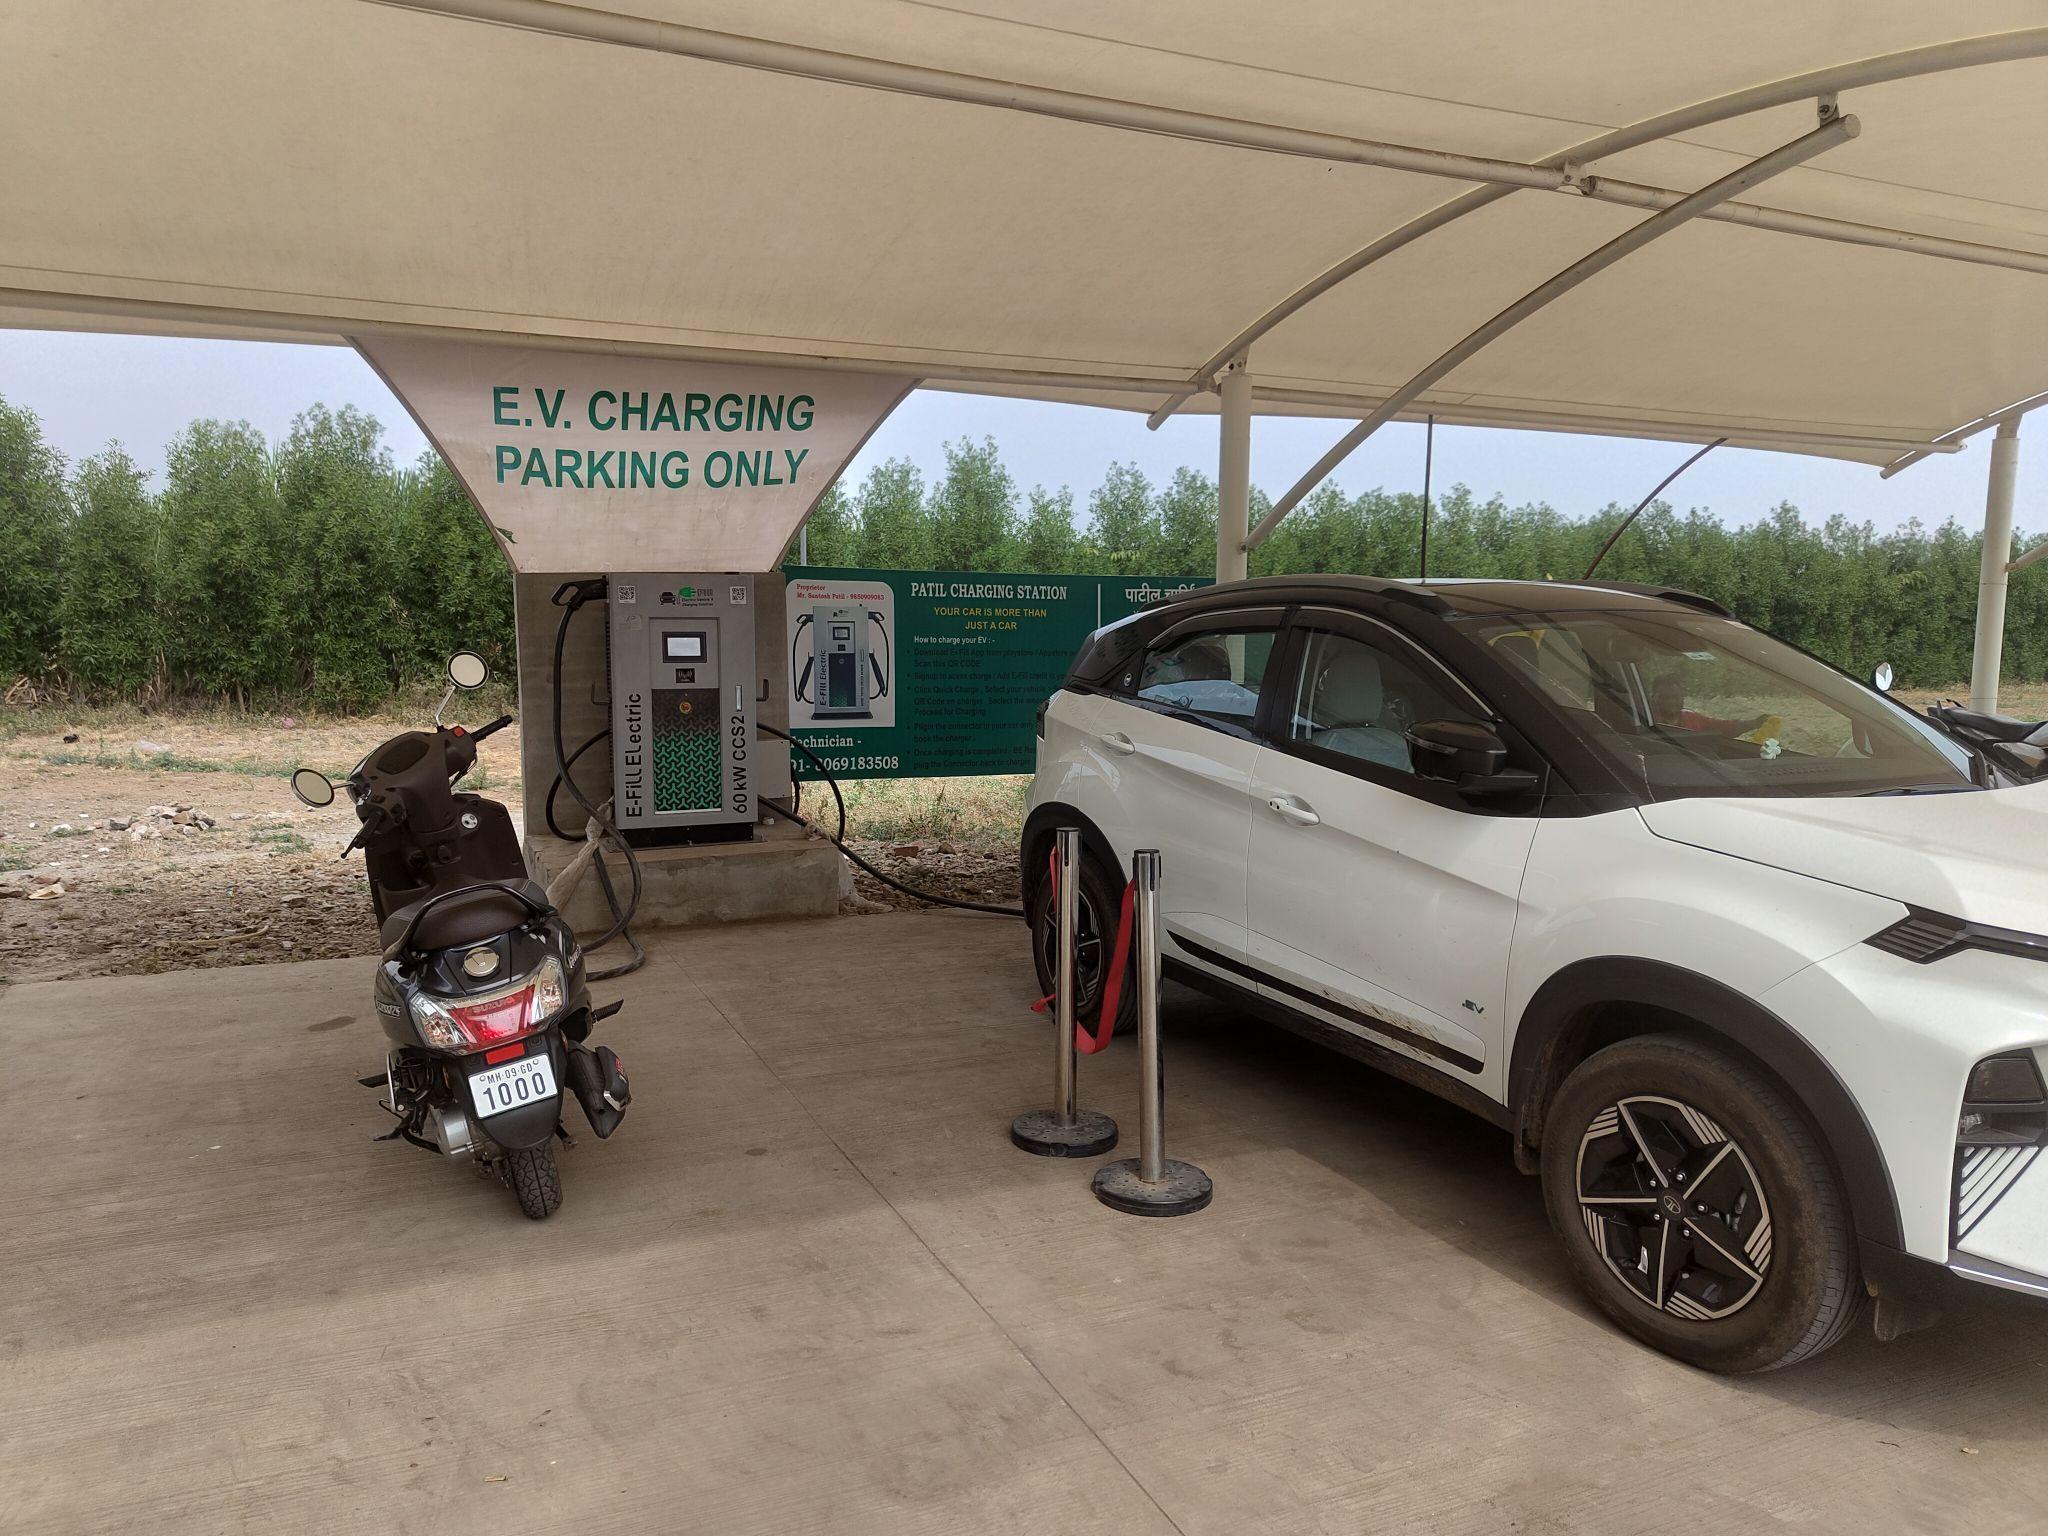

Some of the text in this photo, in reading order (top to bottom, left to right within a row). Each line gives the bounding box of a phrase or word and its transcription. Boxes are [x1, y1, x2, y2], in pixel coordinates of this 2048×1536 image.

[493, 386, 815, 432] E.V. CHARGING
[495, 445, 809, 489] PARKING ONLY
[808, 592, 831, 600] Santosh
[911, 582, 1068, 600] PATIL CHARGING STATION
[1125, 583, 1161, 603] पाटील
[933, 607, 960, 616] YOUR
[962, 607, 982, 616] CAR
[994, 608, 1021, 617] MORE
[1023, 608, 1047, 617] THAN
[965, 621, 1018, 630] JUST A CAR
[914, 635, 929, 644] How
[930, 636, 937, 644] to
[938, 636, 961, 645] charge
[961, 637, 976, 645] your
[977, 636, 987, 644] EV
[731, 715, 746, 761] CCS2
[790, 735, 854, 748] chnician
[483, 1072, 546, 1110] 1000
